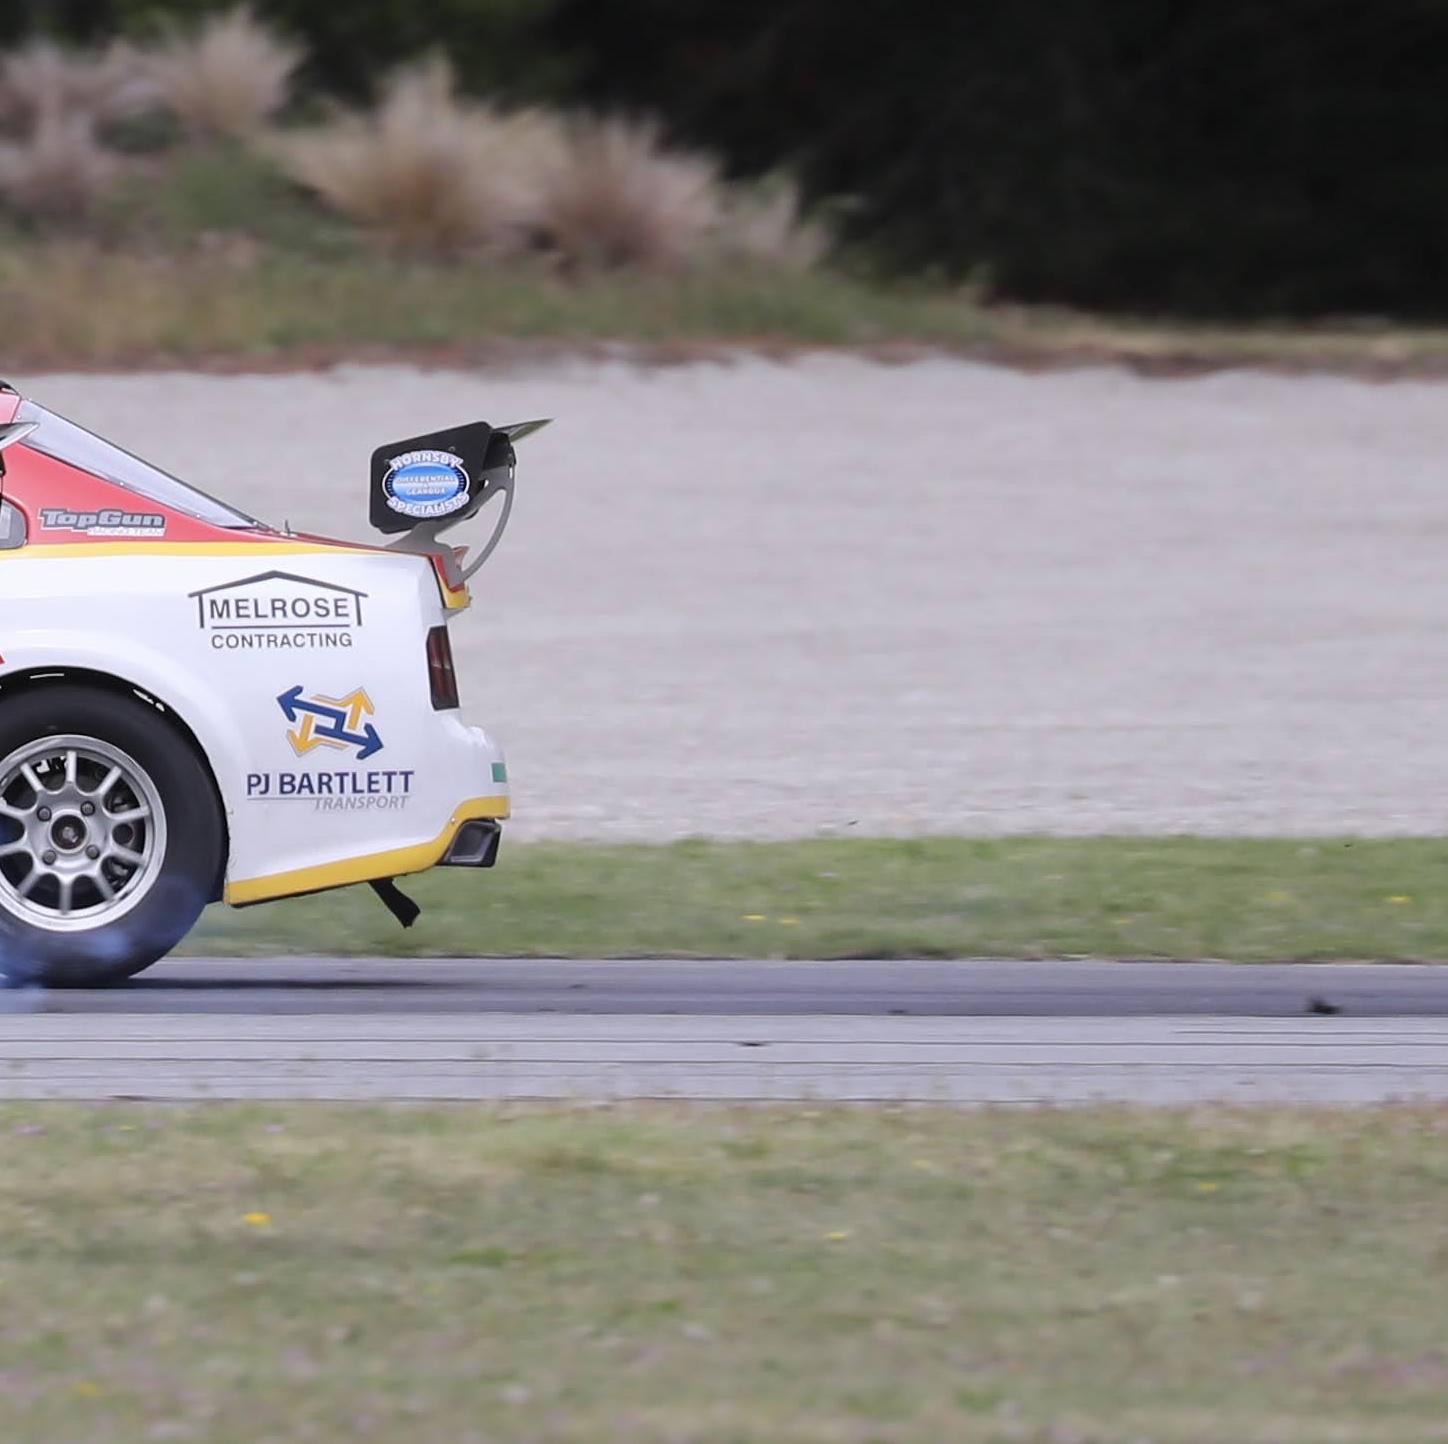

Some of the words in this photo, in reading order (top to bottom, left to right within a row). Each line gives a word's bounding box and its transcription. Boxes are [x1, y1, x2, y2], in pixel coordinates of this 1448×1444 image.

[389, 450, 464, 470] HORNSBY
[387, 492, 469, 517] SPECIALISTS
[42, 510, 164, 528] TopGun
[210, 598, 349, 619] MELROSE
[211, 632, 352, 649] CONTRACTING
[247, 773, 270, 795] PJ
[279, 771, 414, 795] BARTLETT
[315, 796, 409, 811] TRANSPORT
